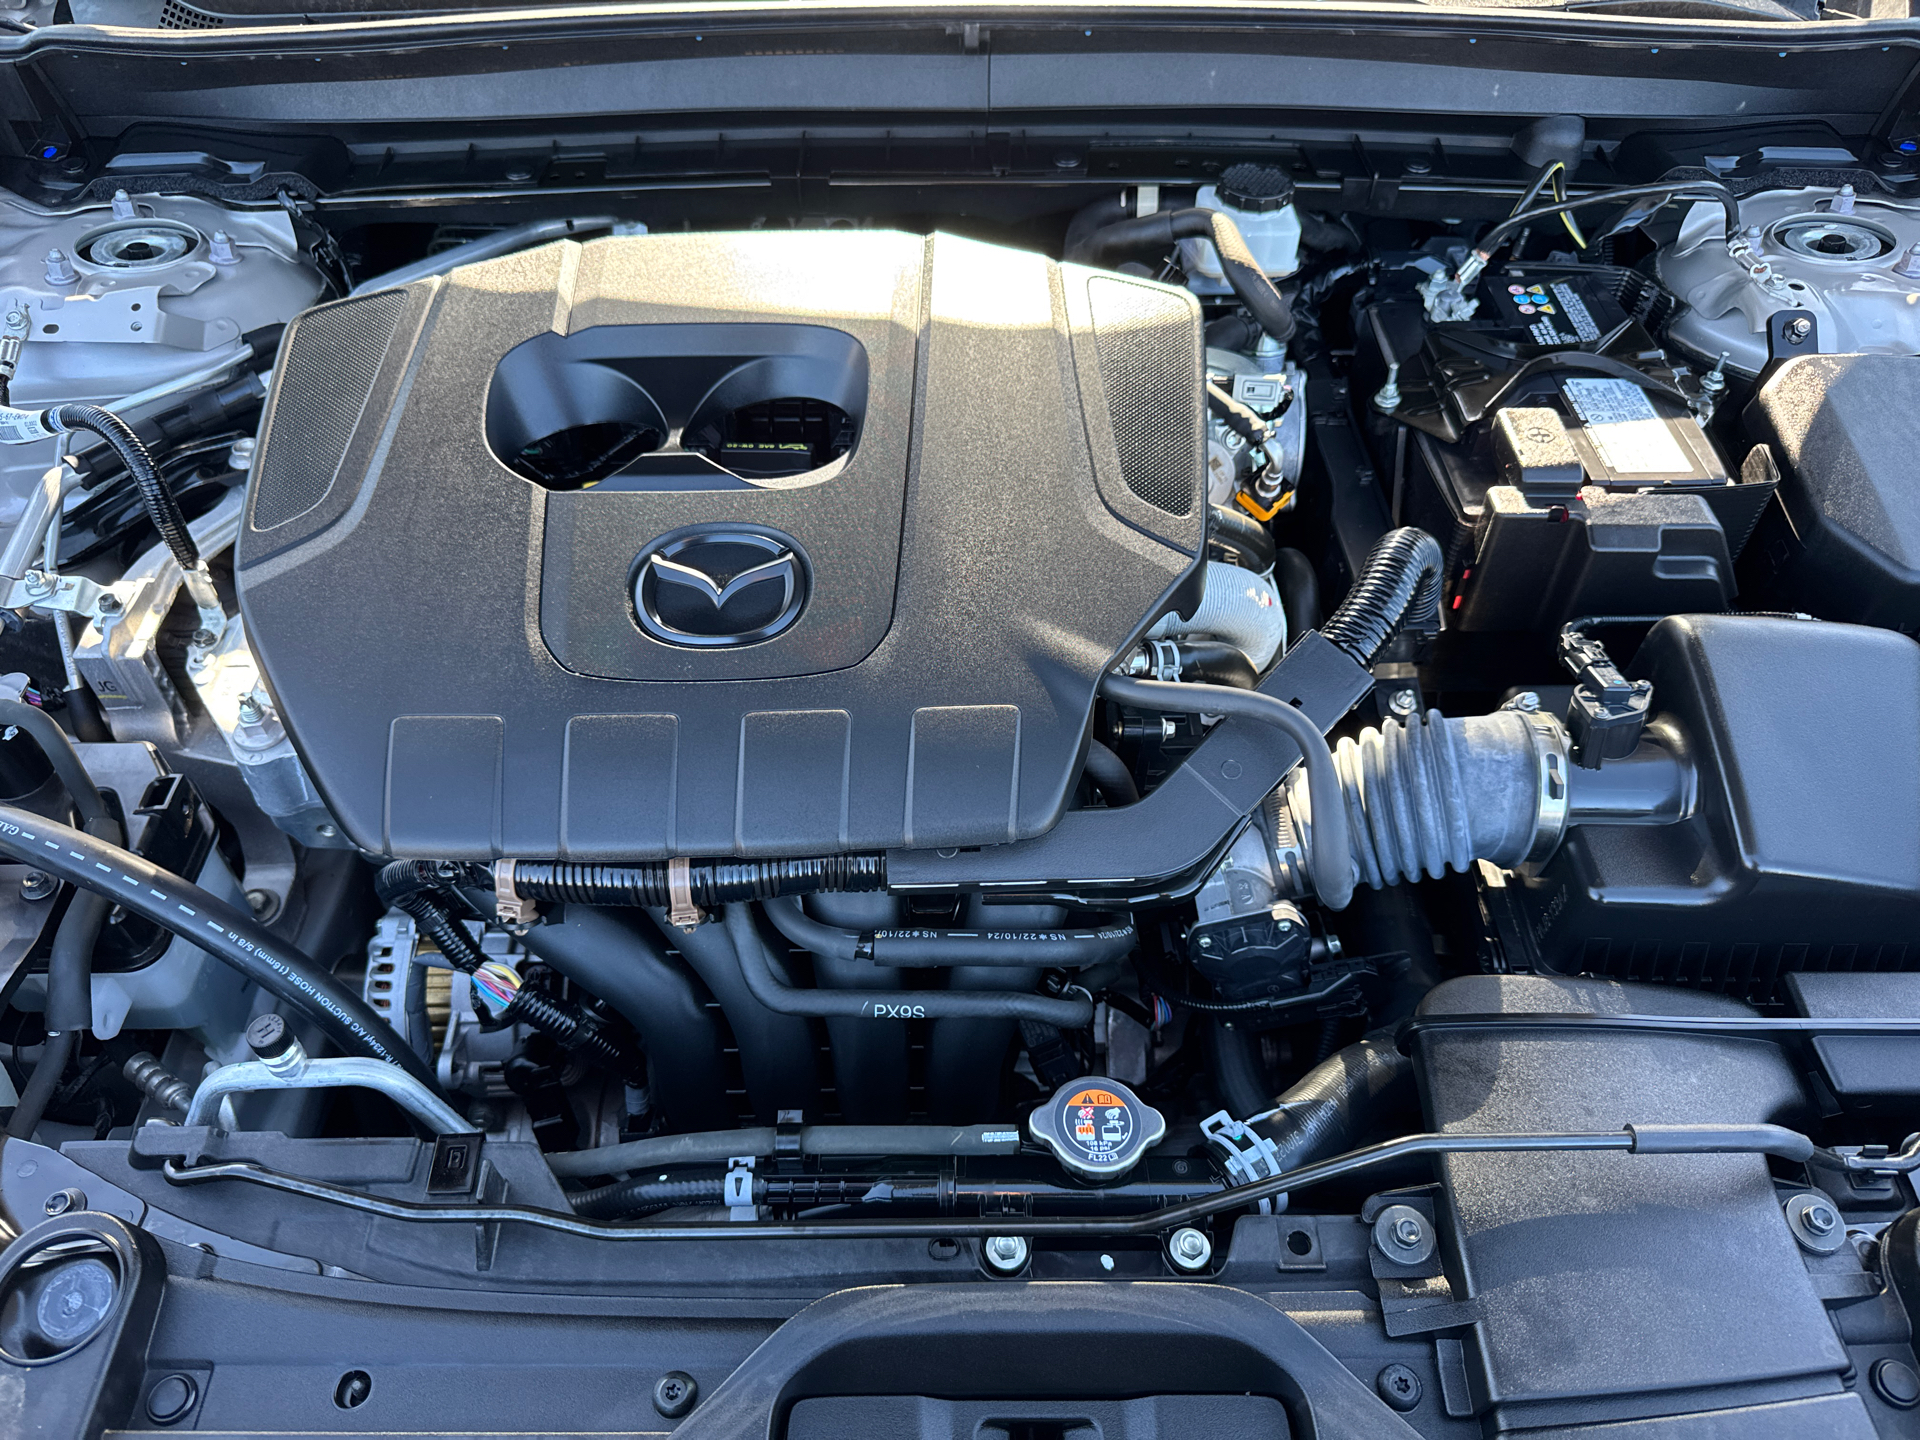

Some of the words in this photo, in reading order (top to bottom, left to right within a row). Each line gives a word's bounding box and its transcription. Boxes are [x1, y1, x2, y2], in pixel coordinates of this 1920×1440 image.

[97, 681, 118, 692] JG
[227, 931, 239, 943] in
[237, 938, 255, 952] 5/8
[253, 947, 291, 975] (16mm)
[287, 971, 316, 996] HOSE
[313, 992, 353, 1026] SUCTION
[874, 1004, 925, 1019] PX9S
[350, 1022, 368, 1037] A/C
[363, 1033, 395, 1063] R-1234yf
[1088, 1153, 1108, 1162] FL22
